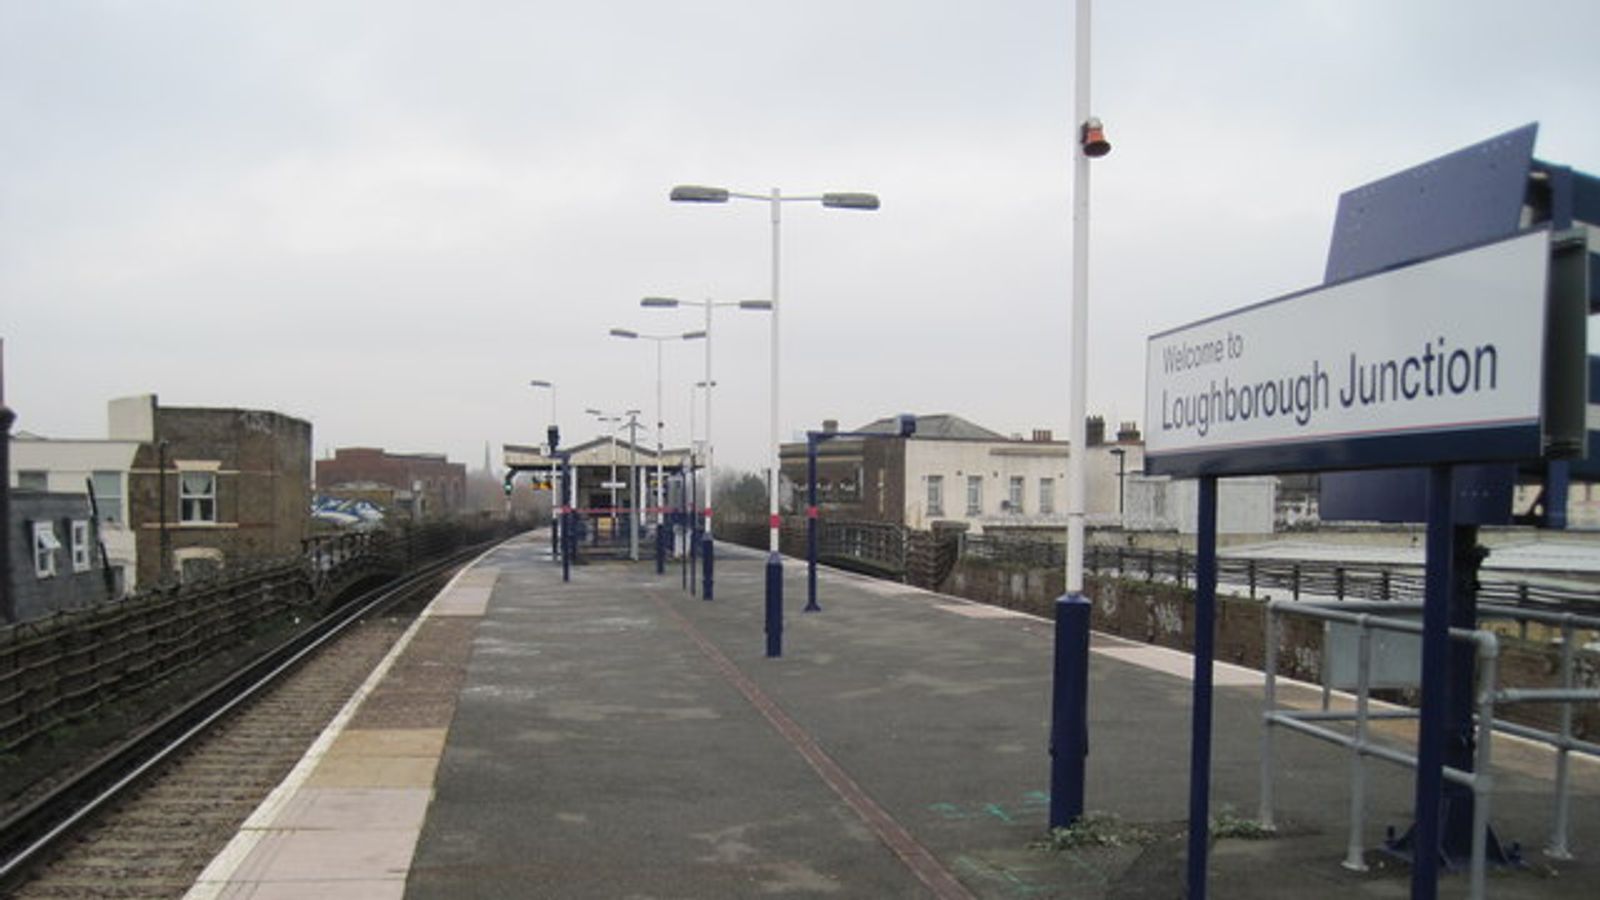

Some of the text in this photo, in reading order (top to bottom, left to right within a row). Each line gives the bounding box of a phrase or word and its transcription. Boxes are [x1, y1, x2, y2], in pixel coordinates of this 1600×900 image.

[1162, 337, 1497, 437] Loughborough Junction
[1163, 332, 1243, 374] Welcome to
